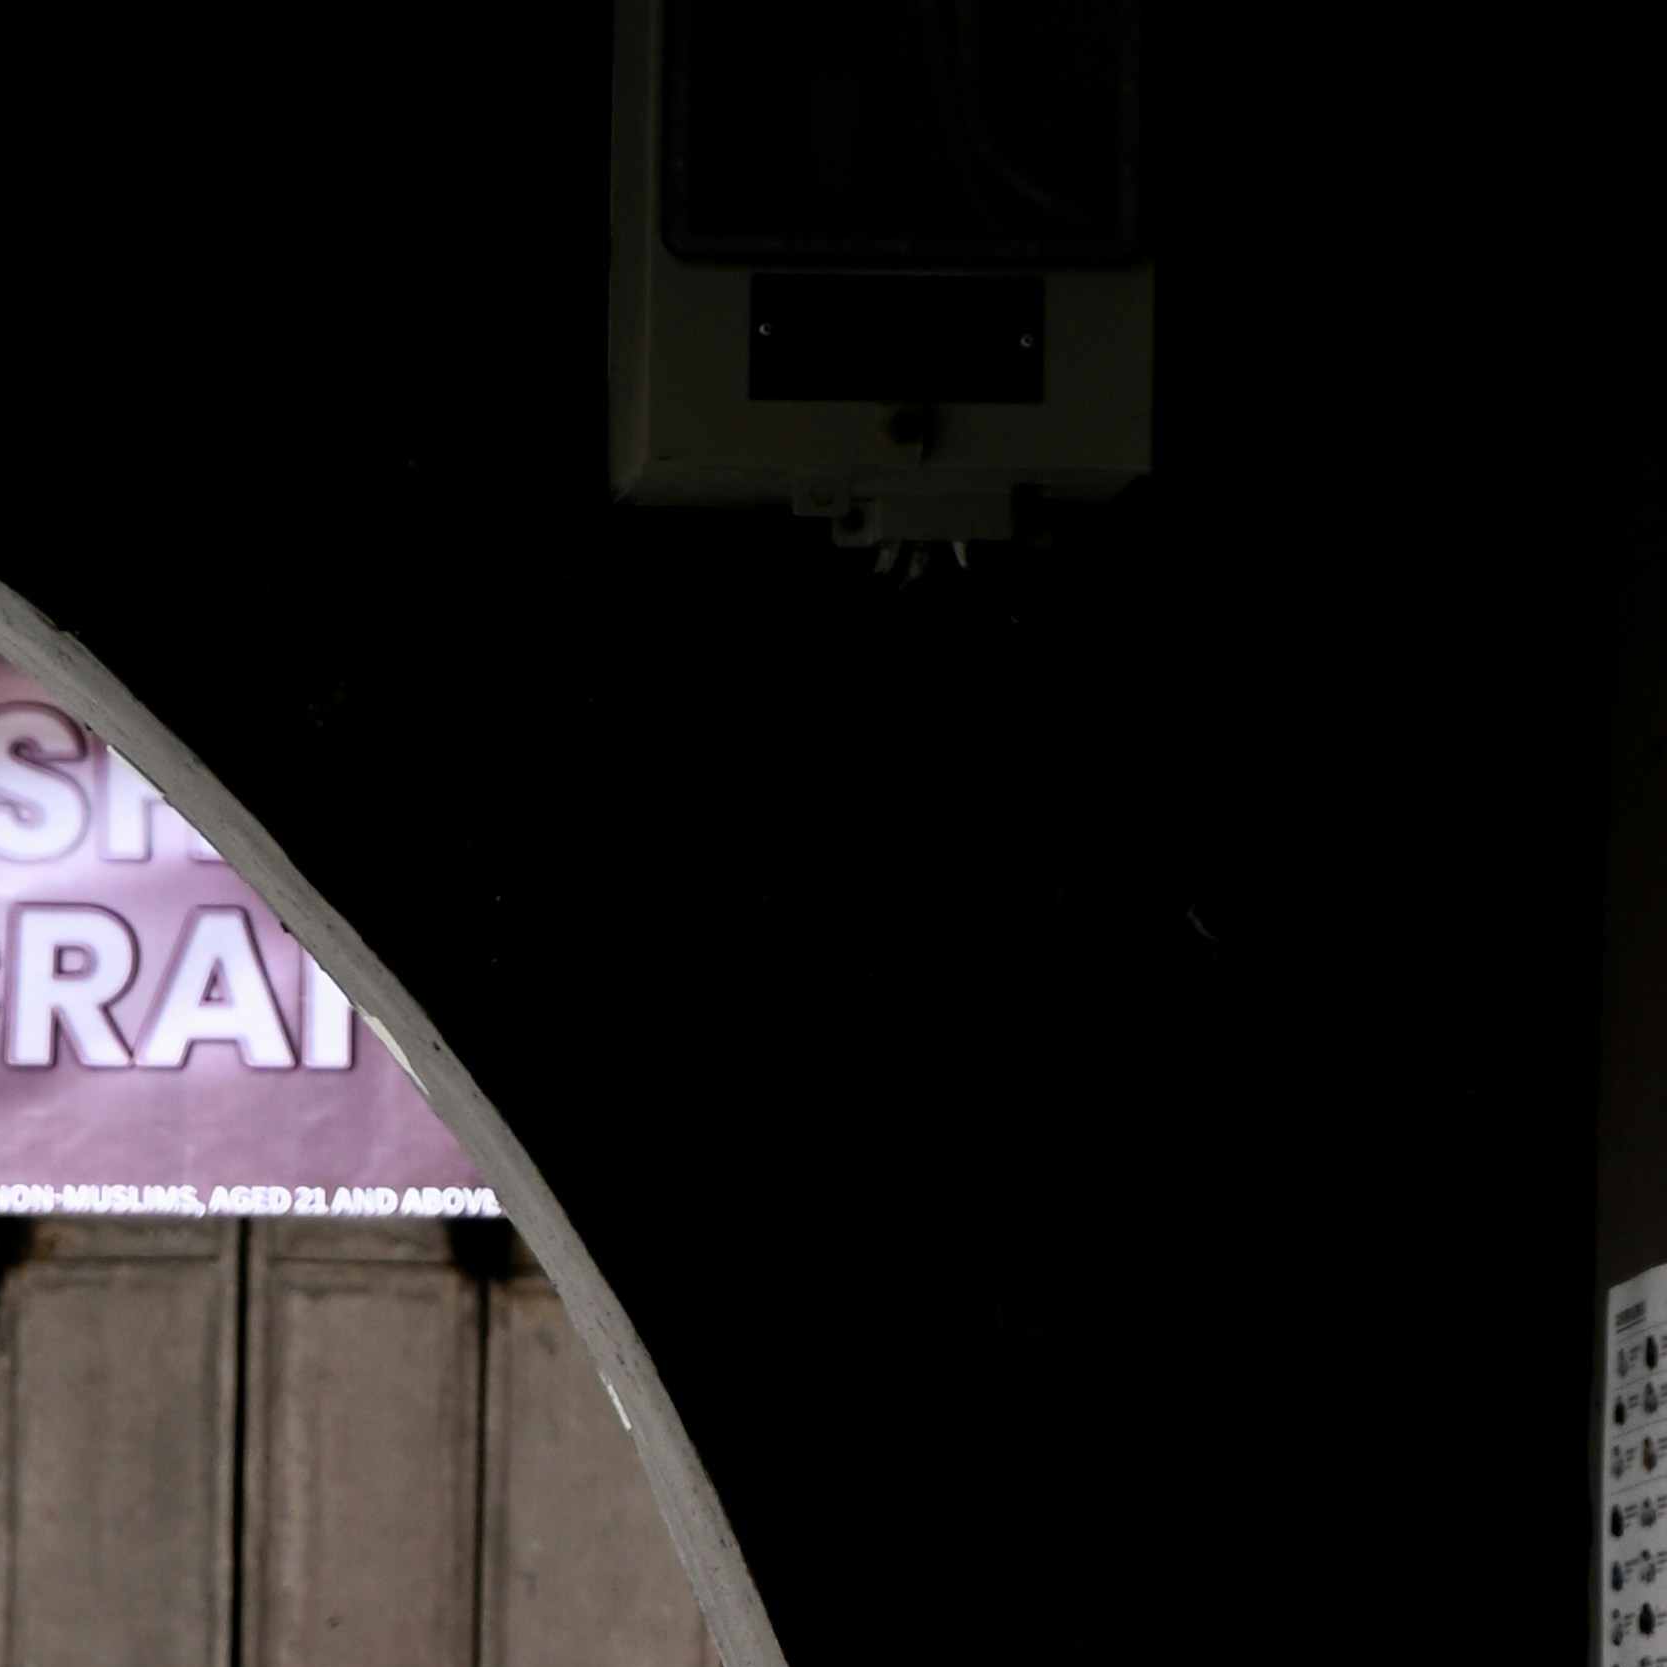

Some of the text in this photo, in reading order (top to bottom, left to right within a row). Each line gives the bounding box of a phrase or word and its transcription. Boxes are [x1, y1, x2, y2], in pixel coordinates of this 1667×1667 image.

[208, 1186, 292, 1216] AGED
[293, 1187, 329, 1216] 21
[330, 1187, 399, 1217] AND
